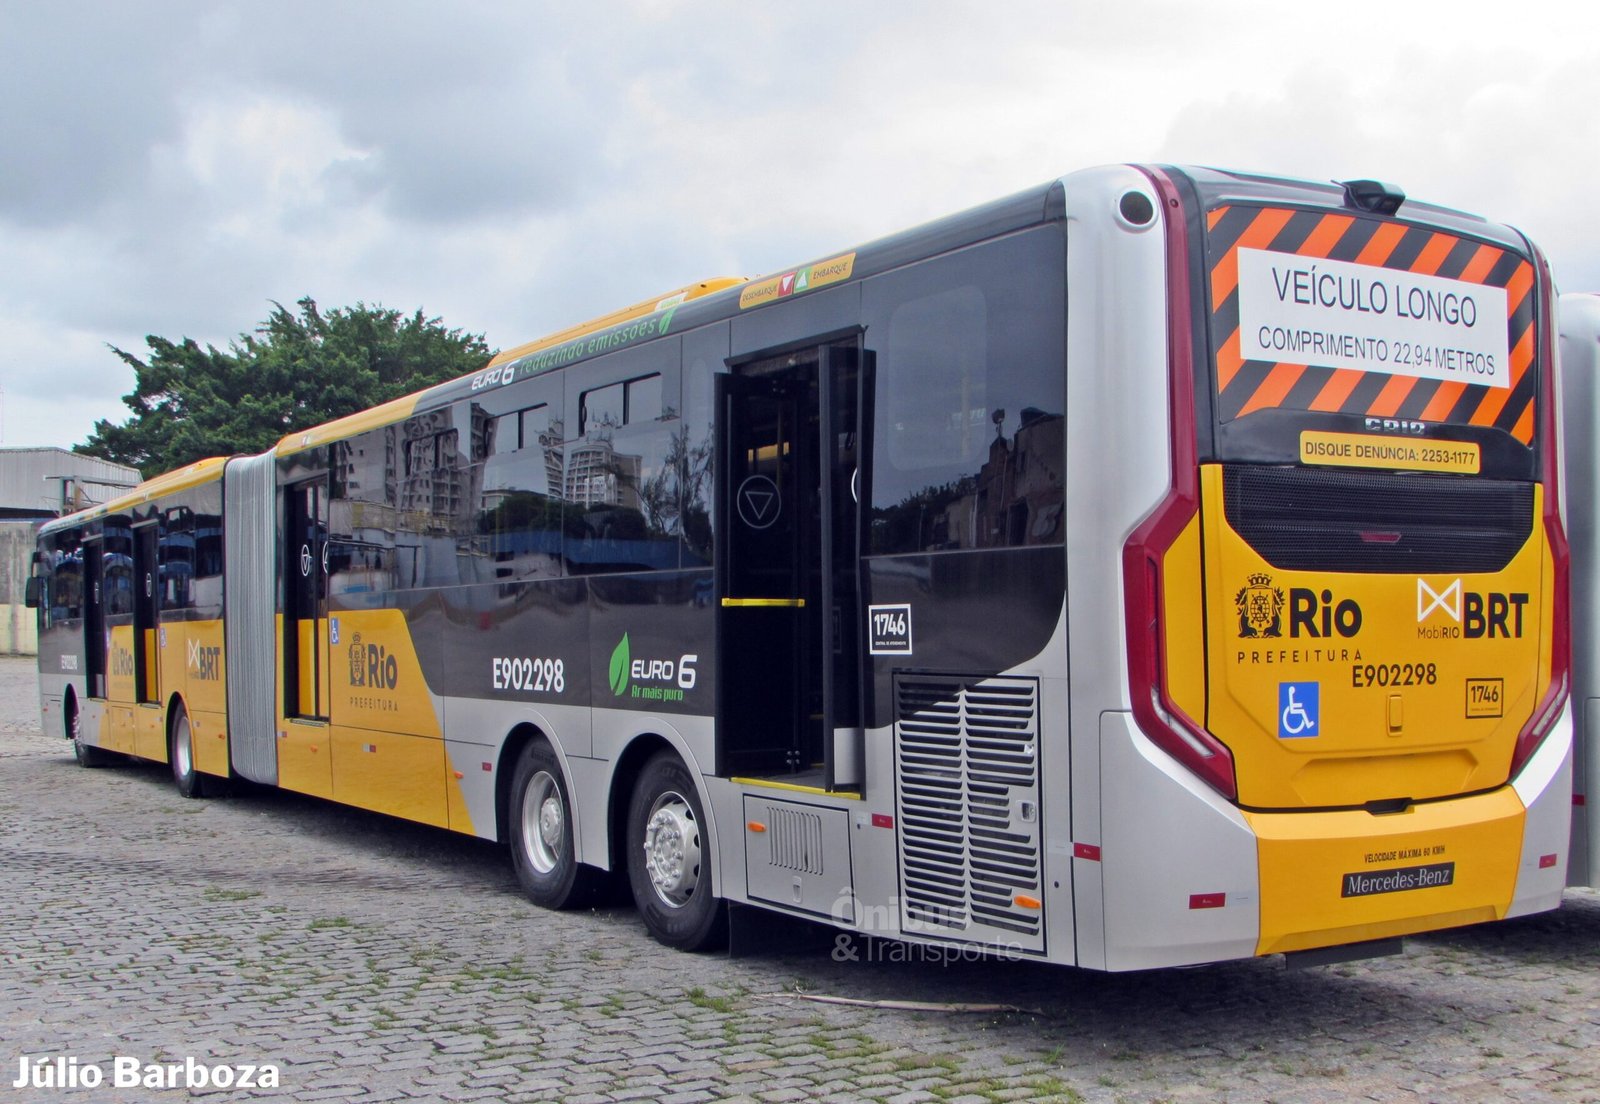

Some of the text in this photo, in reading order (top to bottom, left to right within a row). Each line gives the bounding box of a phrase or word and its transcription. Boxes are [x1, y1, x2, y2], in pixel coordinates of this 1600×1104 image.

[813, 262, 848, 280] EMBARQUE
[742, 286, 777, 301] DESEMBARQUE
[1272, 265, 1477, 328] VEÍCULO LONGO
[471, 317, 657, 391] EURO 6 reduzindo emissões
[1258, 325, 1495, 376] COMPRIMENTO 22,94 METROS
[1305, 442, 1476, 465] DISQUE DENÚNCIA: 2253-1177
[874, 613, 906, 636] 1746
[1289, 588, 1363, 638] Rio
[1463, 592, 1530, 639] BRT
[1417, 626, 1460, 640] MobiRIO
[119, 648, 134, 676] Rio
[199, 646, 221, 681] BRT
[367, 643, 398, 690] Rio
[1237, 649, 1362, 664] PREFEITURA
[492, 657, 564, 693] E902298
[631, 654, 698, 689] EURO 6
[1352, 663, 1437, 688] E902298
[349, 696, 398, 712] PREFEITURA
[631, 684, 684, 702] Ar mais puro
[1470, 685, 1499, 703] 1746
[1364, 851, 1397, 863] VELOCIDADE
[1347, 868, 1450, 895] Mercedes-Benz
